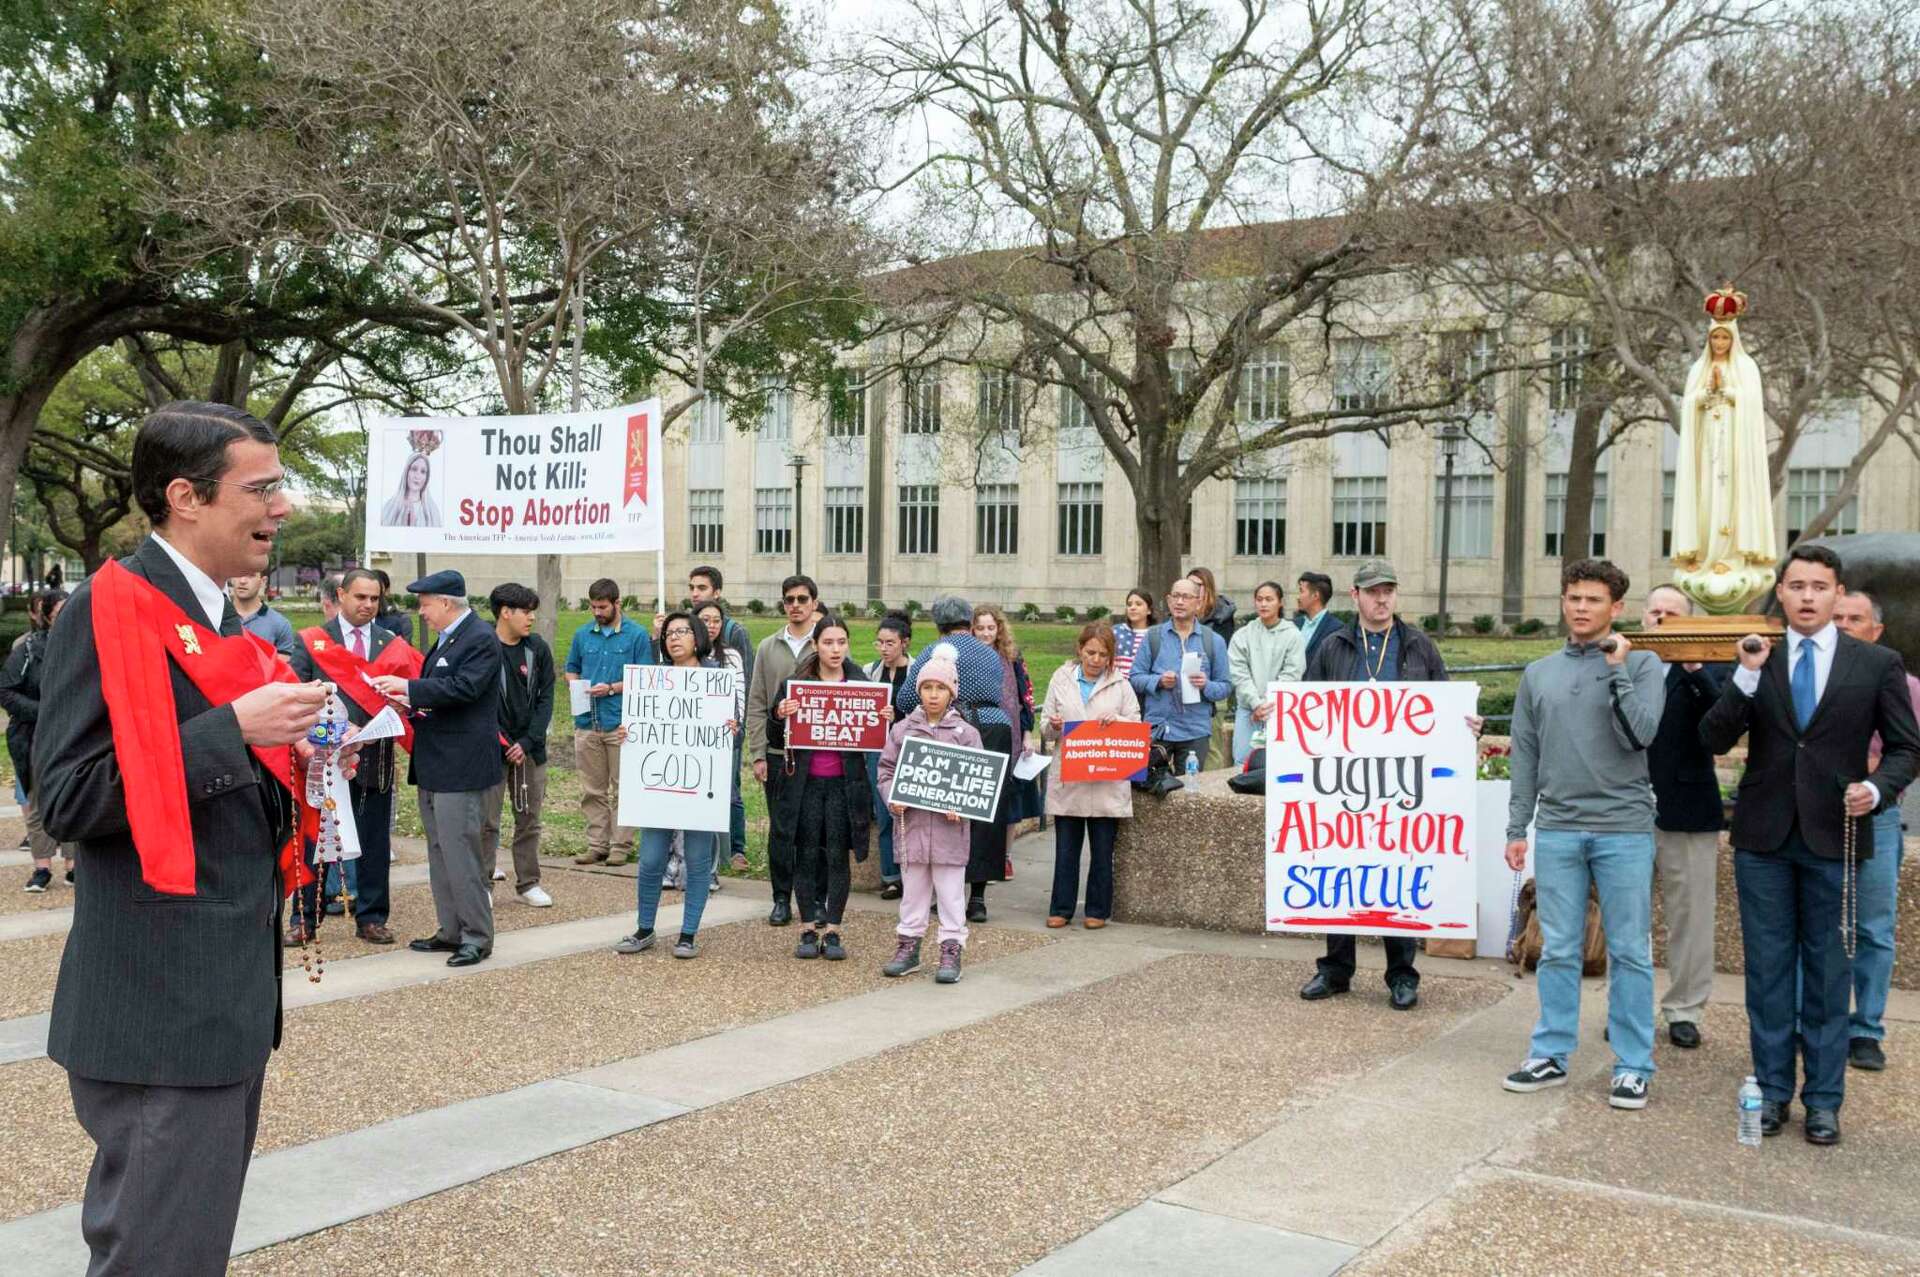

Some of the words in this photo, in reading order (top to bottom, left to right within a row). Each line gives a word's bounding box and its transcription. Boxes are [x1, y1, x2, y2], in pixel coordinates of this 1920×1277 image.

[481, 428, 541, 456] Thou
[550, 423, 603, 454] Shall
[496, 462, 537, 491] Not
[545, 461, 587, 490] Kill:
[459, 498, 514, 533] Stop
[522, 496, 611, 526] Abortion
[626, 667, 675, 691] TEXAS
[684, 670, 700, 693] IS
[668, 696, 704, 720] ONE
[801, 696, 828, 709] LET
[833, 697, 876, 710] THEIR
[797, 708, 880, 727] HEARTS
[626, 722, 680, 746] STATE
[685, 724, 732, 750] UNDER
[811, 725, 865, 742] BEAT
[1065, 738, 1103, 748] Remove
[1104, 737, 1146, 748] Satanic
[907, 751, 915, 764] I
[921, 755, 951, 770] AM
[958, 761, 994, 778] THE
[1065, 749, 1108, 760] Abortion
[1109, 749, 1145, 760] Statue
[898, 763, 997, 796] PRO-LIFE
[897, 782, 991, 810] GENERATION
[1273, 799, 1468, 857] Abortion
[1283, 863, 1434, 911] STATUE
